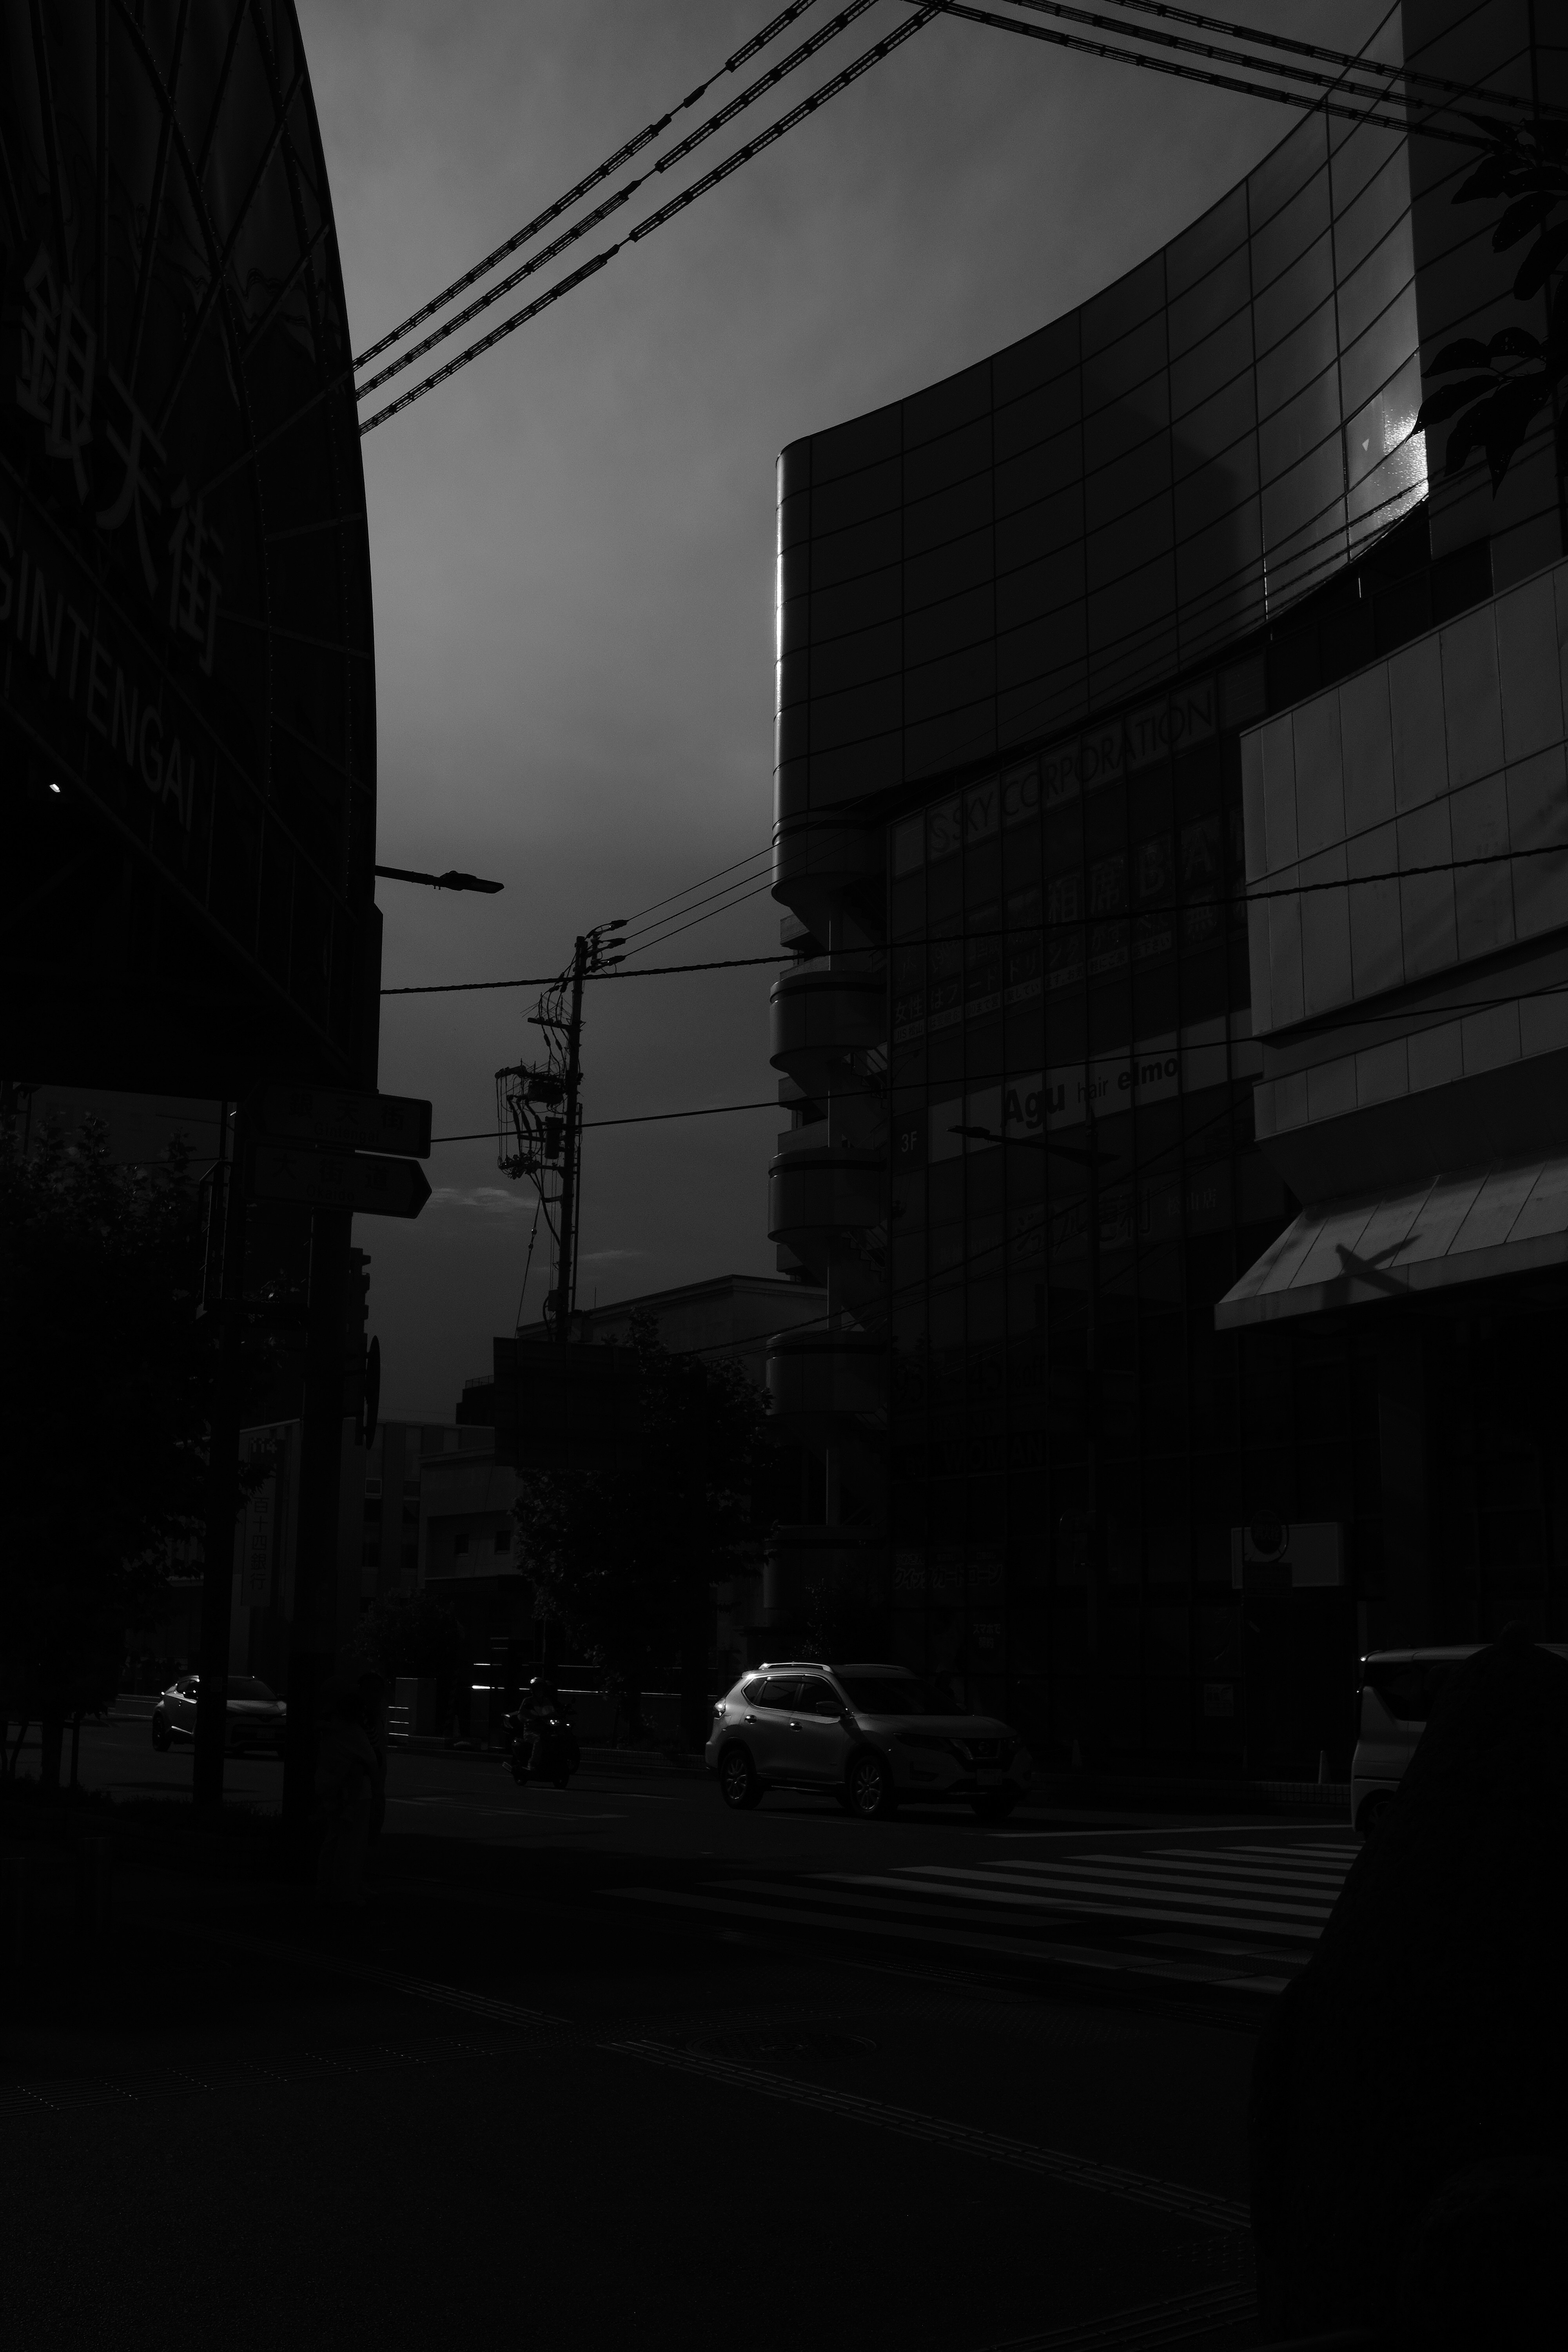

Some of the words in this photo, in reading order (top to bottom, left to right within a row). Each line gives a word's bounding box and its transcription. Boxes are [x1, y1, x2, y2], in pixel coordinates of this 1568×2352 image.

[16, 240, 224, 677] 銀天街
[1003, 691, 1212, 817] CORPORATION
[1048, 813, 1244, 930] 相席BA
[289, 1092, 405, 1131] 銀天街
[1001, 1083, 1065, 1130] Agu
[1077, 1078, 1109, 1103] hair
[1118, 1057, 1178, 1091] elmo
[314, 1122, 379, 1144] Gintengai
[901, 1131, 918, 1153] 3F
[272, 1153, 389, 1191] 大街道
[307, 1184, 355, 1202] Okaido
[1167, 1189, 1216, 1216] 松山店
[943, 1434, 1043, 1472] WOMAN
[250, 1497, 268, 1590] 百十四銀行
[1254, 1524, 1279, 1541] 消火栓
[973, 1623, 1000, 1634] スマホで
